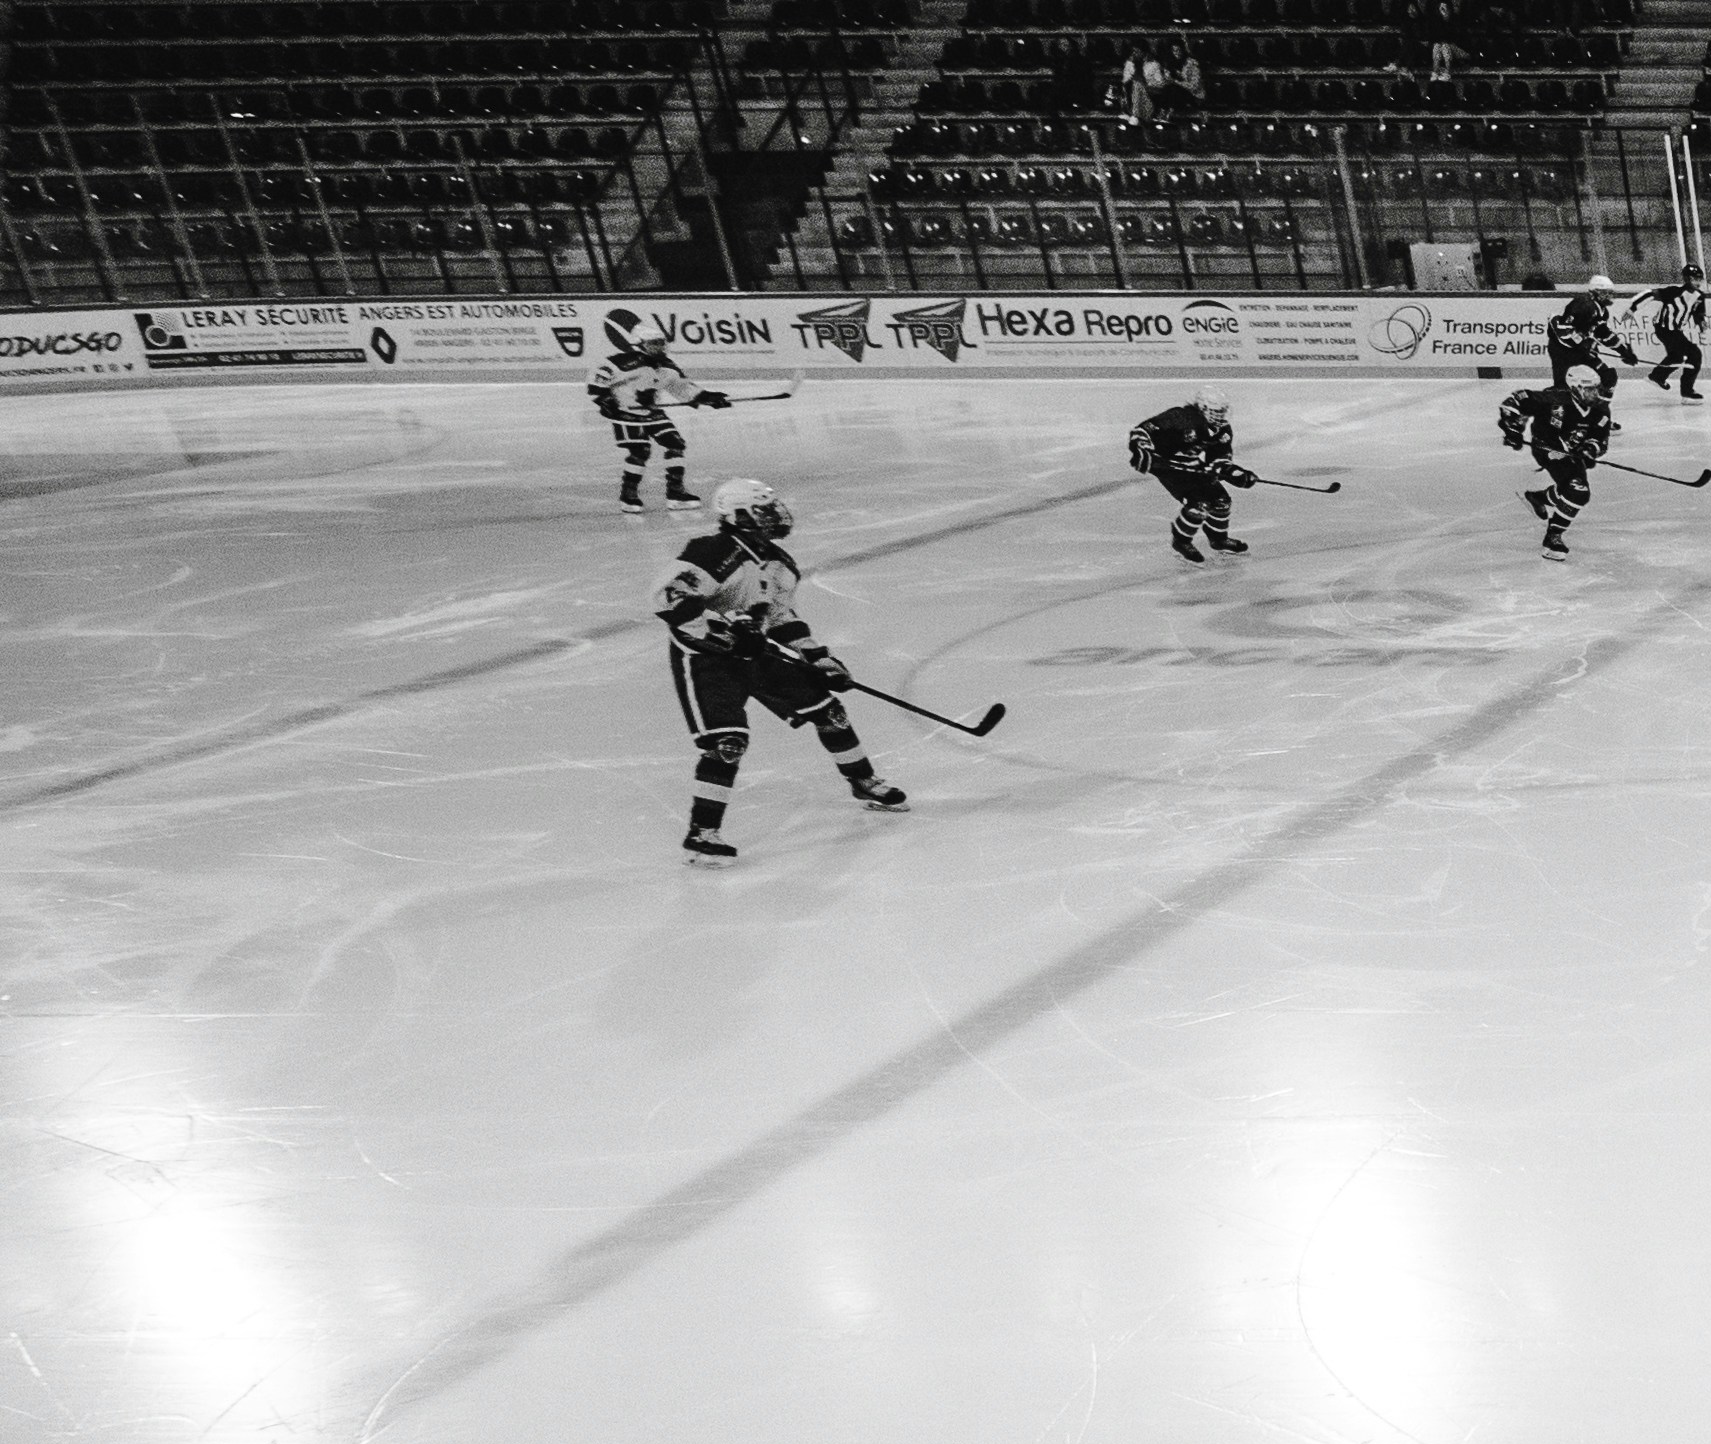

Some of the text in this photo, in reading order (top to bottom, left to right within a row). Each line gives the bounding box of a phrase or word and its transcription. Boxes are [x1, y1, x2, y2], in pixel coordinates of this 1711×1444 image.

[181, 310, 247, 327] LERAY
[360, 303, 578, 320] ANGERS EST AUTOMOBILES
[976, 303, 1173, 342] Hexa Repro
[1443, 319, 1545, 338] Transports
[1432, 340, 1498, 356] France
